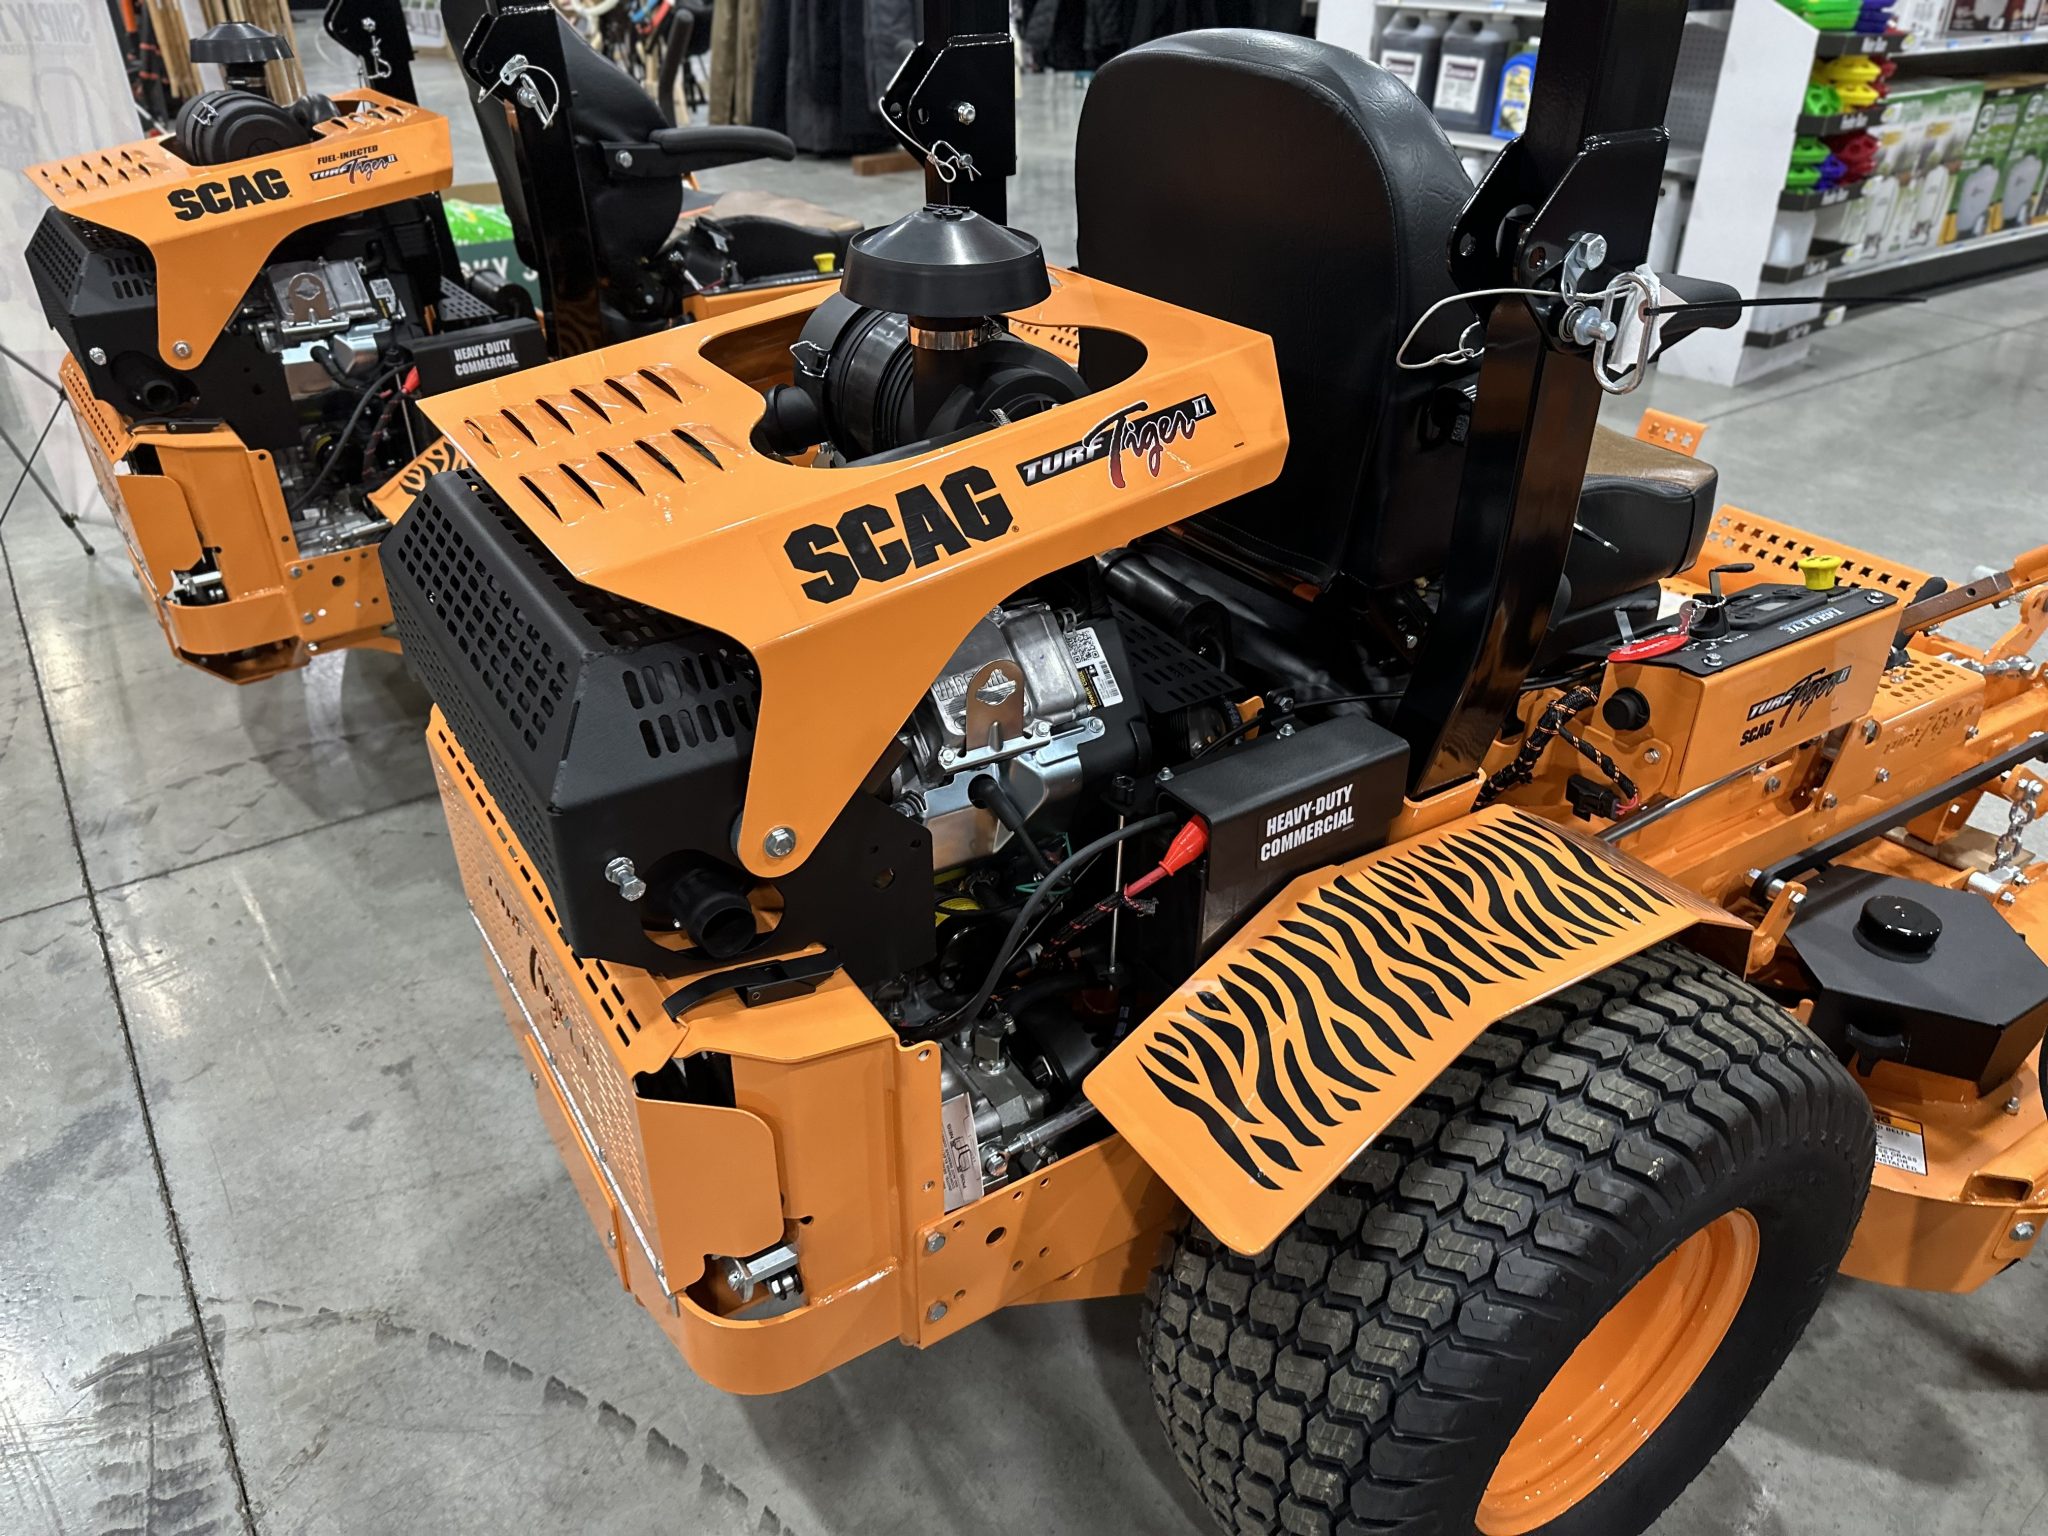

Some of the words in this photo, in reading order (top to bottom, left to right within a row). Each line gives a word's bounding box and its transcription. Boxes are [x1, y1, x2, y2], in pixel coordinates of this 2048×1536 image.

[312, 165, 348, 180] TURF
[340, 155, 388, 184] Tiger
[317, 145, 378, 165] FUEL-INJECTED
[167, 168, 290, 221] SCAG
[454, 338, 511, 361] HEAVY-DUTY
[454, 352, 519, 376] COMMERCIAL
[1022, 437, 1105, 483] TURF
[1081, 400, 1196, 489] Tiger
[1192, 396, 1211, 418] II
[783, 466, 1013, 603] SCAG
[1749, 689, 1796, 719] TURF
[1780, 668, 1837, 728] Tiger
[1739, 720, 1775, 746] SCAG
[1260, 806, 1354, 862] COMMERCIAL
[1266, 784, 1353, 837] HEAVY-DUTY
